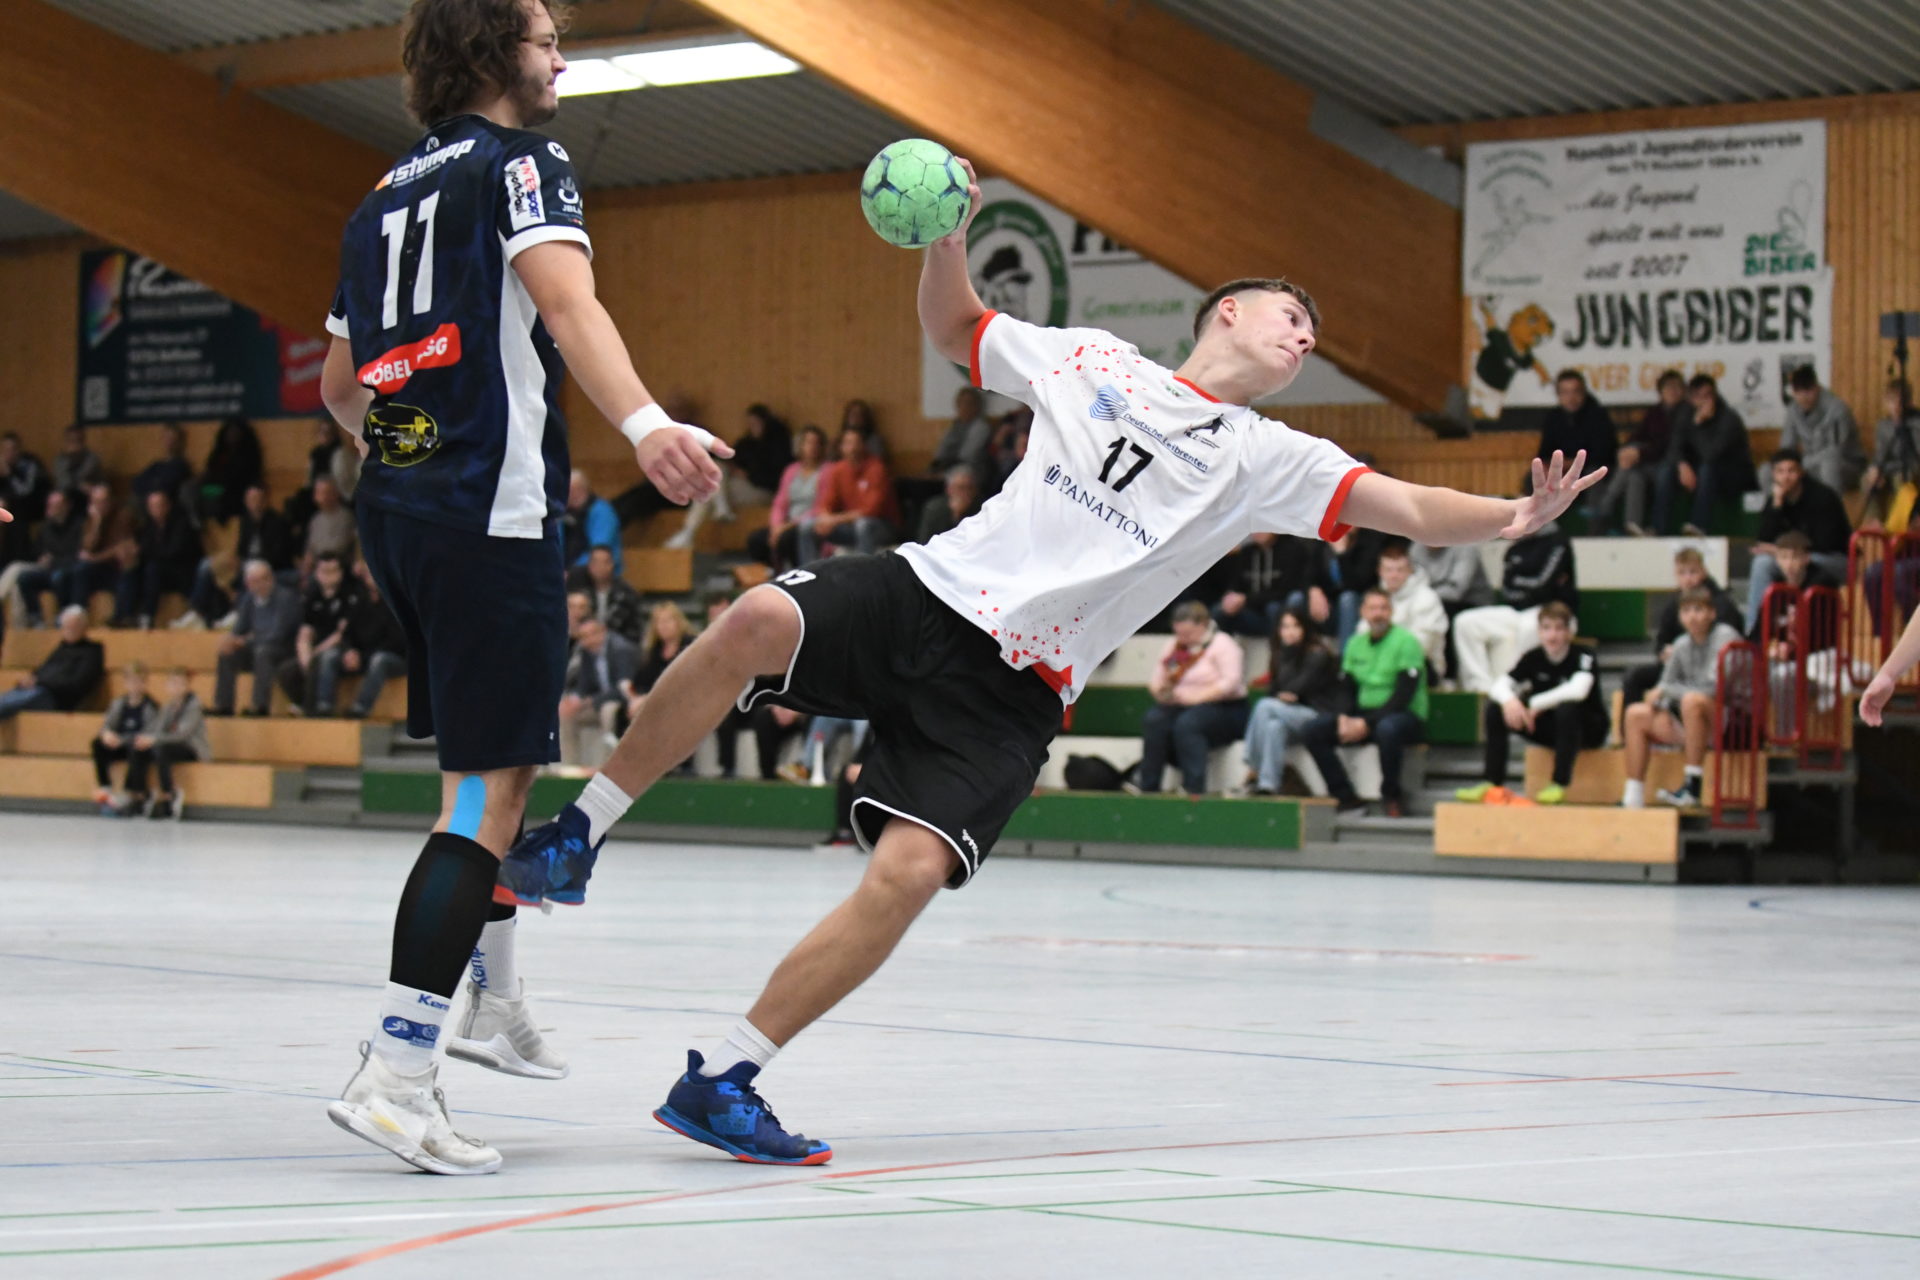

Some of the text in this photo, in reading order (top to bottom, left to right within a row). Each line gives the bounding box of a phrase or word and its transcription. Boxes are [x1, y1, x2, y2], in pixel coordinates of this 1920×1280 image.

[394, 139, 476, 182] stumpp
[522, 165, 541, 218] INTERSPORT
[1624, 182, 1699, 212] Jugend
[1587, 222, 1724, 246] spielt mit uns
[381, 190, 440, 330] 11
[1629, 252, 1689, 277] 2007
[1743, 251, 1816, 277] BIBER
[1097, 435, 1155, 493] 17
[1123, 413, 1163, 438] Deutsche
[1163, 436, 1208, 471] Leibrenten
[1059, 475, 1160, 549] PANATTONI
[470, 945, 489, 990] Kemp
[417, 993, 450, 1011] Kem
